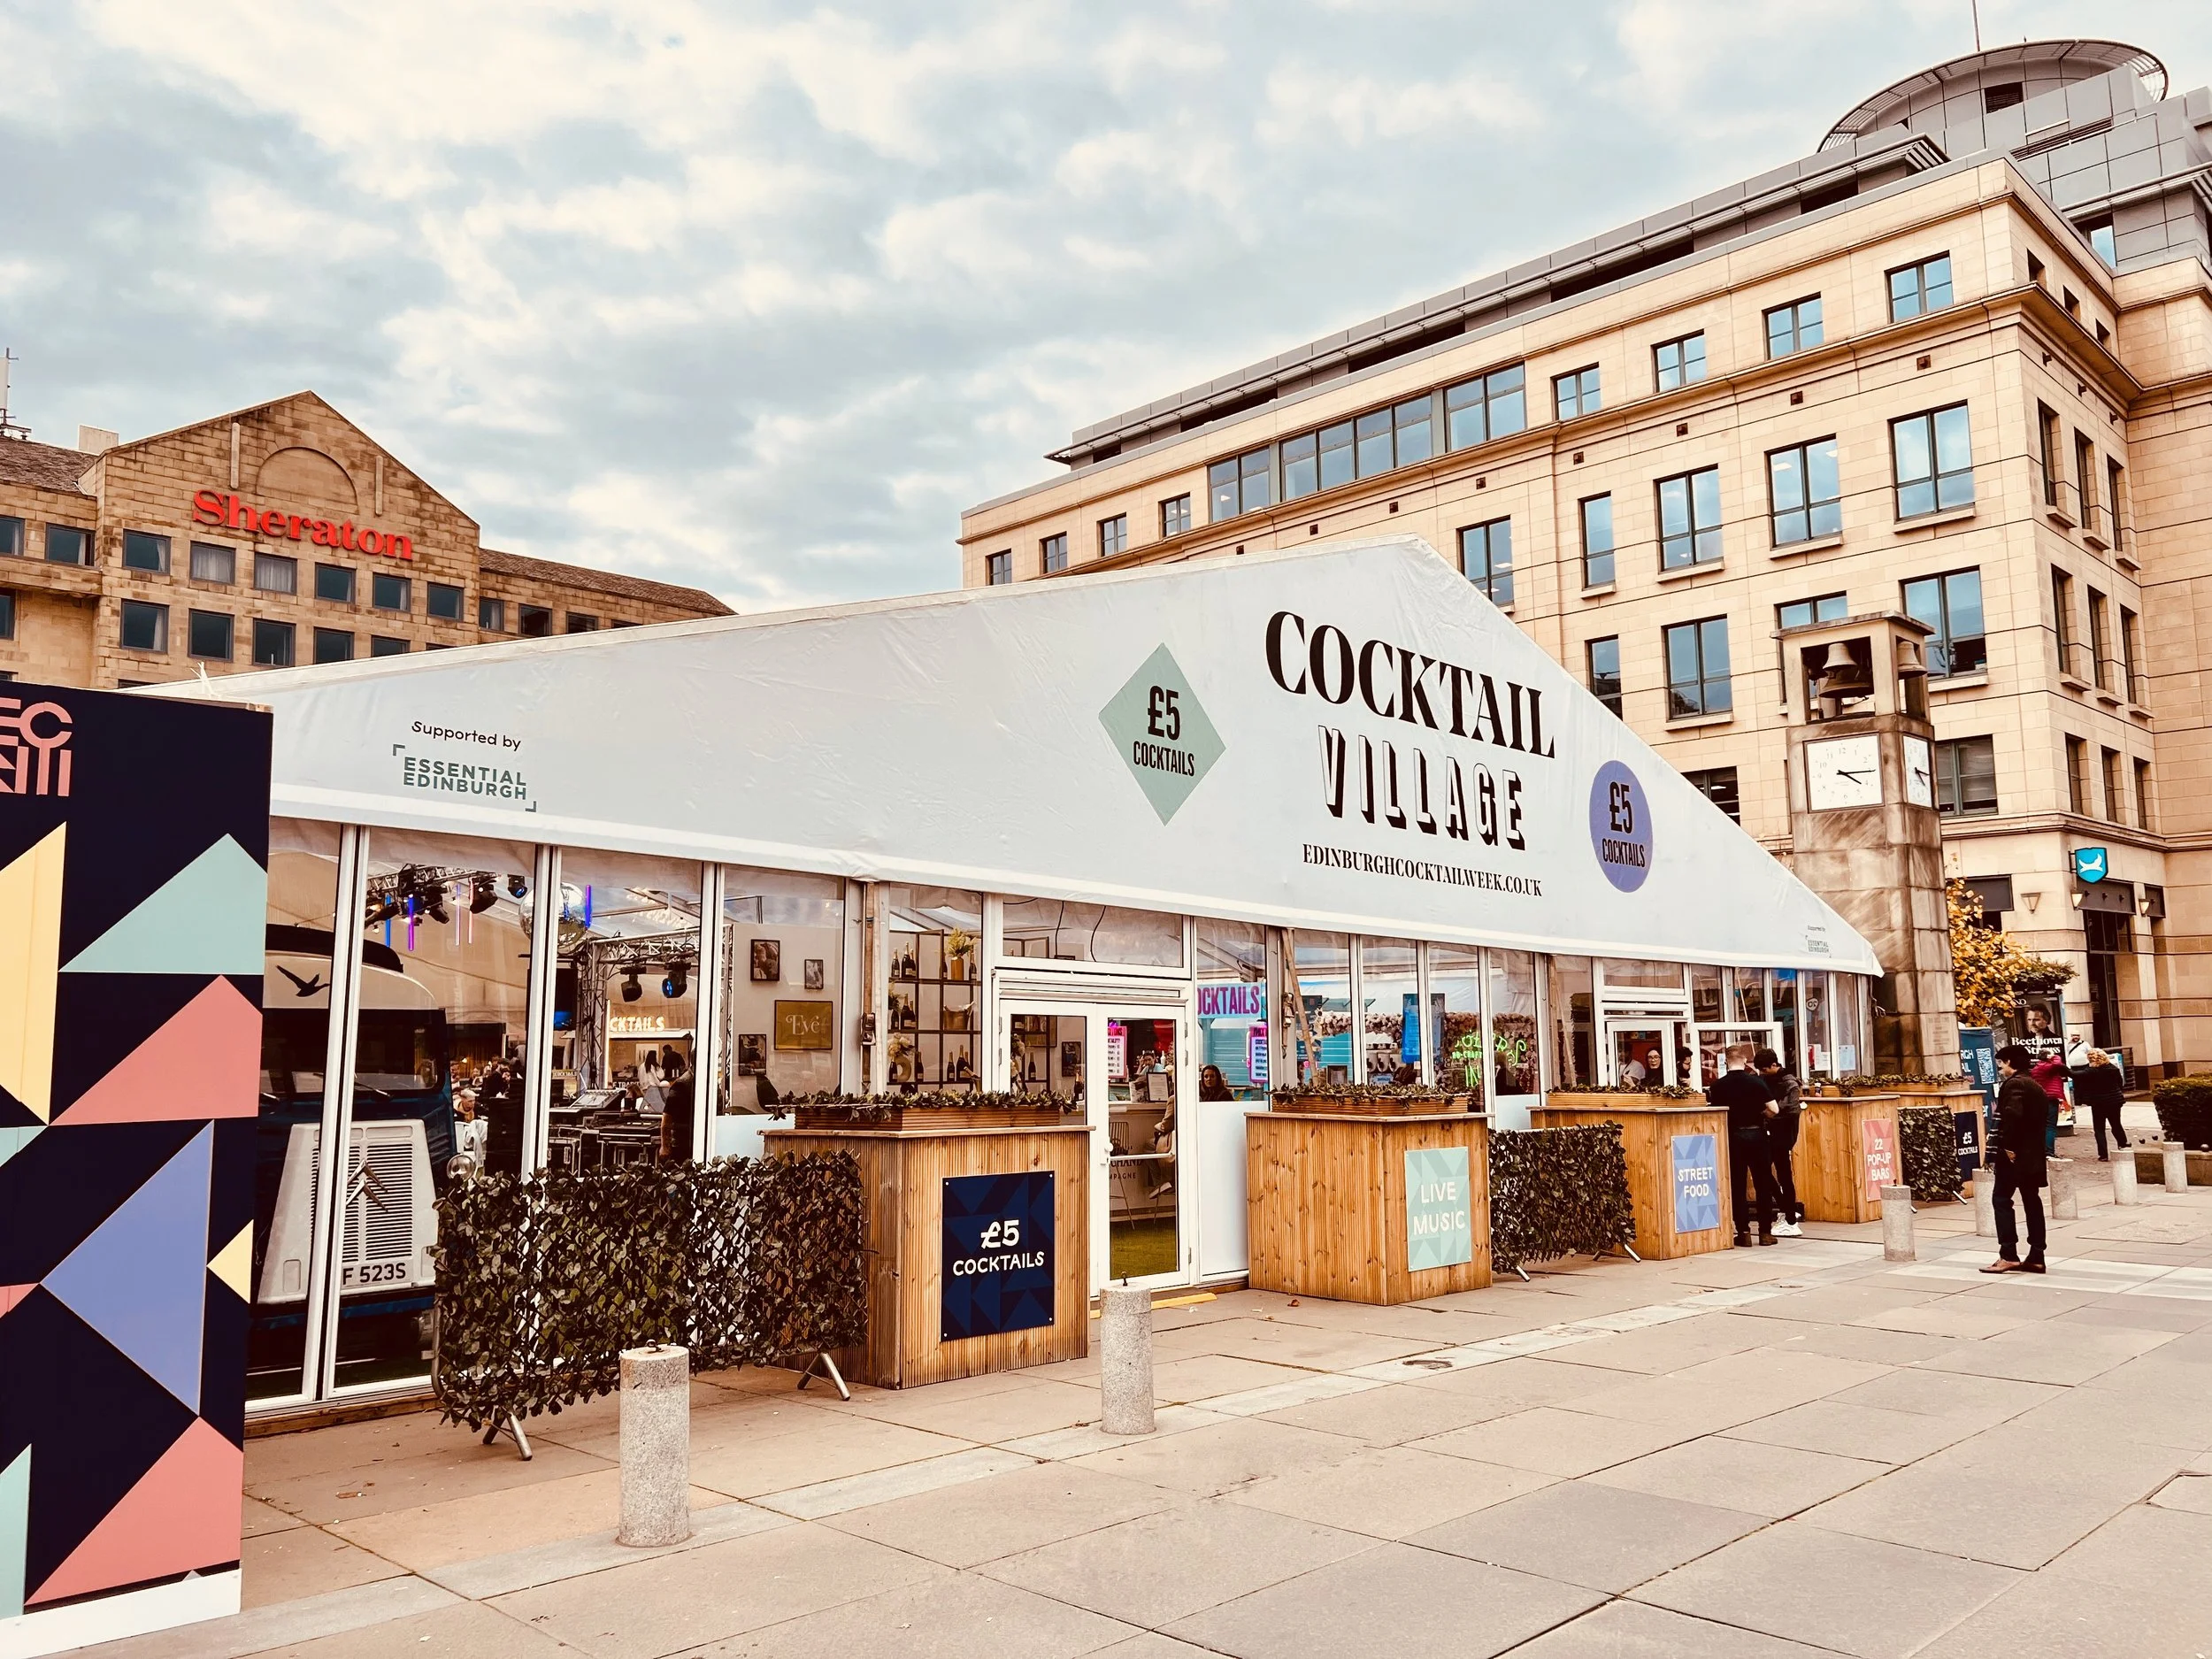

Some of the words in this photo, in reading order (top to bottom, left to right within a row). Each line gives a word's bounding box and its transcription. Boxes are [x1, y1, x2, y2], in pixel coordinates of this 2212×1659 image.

[193, 489, 412, 560] Sheraton
[1265, 611, 1555, 759] COCKTAIL
[1148, 685, 1180, 741] £5
[411, 720, 497, 746] Supported
[503, 734, 521, 752] by
[403, 757, 526, 787] ESSENTIAL
[1133, 740, 1194, 777] COCKTAILS
[403, 772, 526, 800] EDINBURGH
[1317, 725, 1525, 851] VILLAGE
[1609, 781, 1632, 833] £5
[1601, 838, 1646, 868] COCKTAILS
[1302, 843, 1542, 897] EDINBURGHCOCKTAILWEEK.CO.UK
[1197, 985, 1260, 1016] OCKTAILS
[609, 1017, 665, 1032] CKTAILS
[2011, 1036, 2062, 1046] Beethoven
[1874, 1138, 1884, 1150] 22
[1962, 1132, 1972, 1145] £5
[1867, 1152, 1891, 1167] POP-UP
[1678, 1166, 1713, 1182] STREET
[1871, 1168, 1890, 1182] BARS
[1421, 1181, 1456, 1203] LIVE
[1684, 1183, 1709, 1199] FOOD
[980, 1219, 1020, 1249] £5
[1413, 1210, 1466, 1236] MUSIC
[359, 1263, 406, 1283] 523S
[953, 1251, 1045, 1276] COCKTAILS
